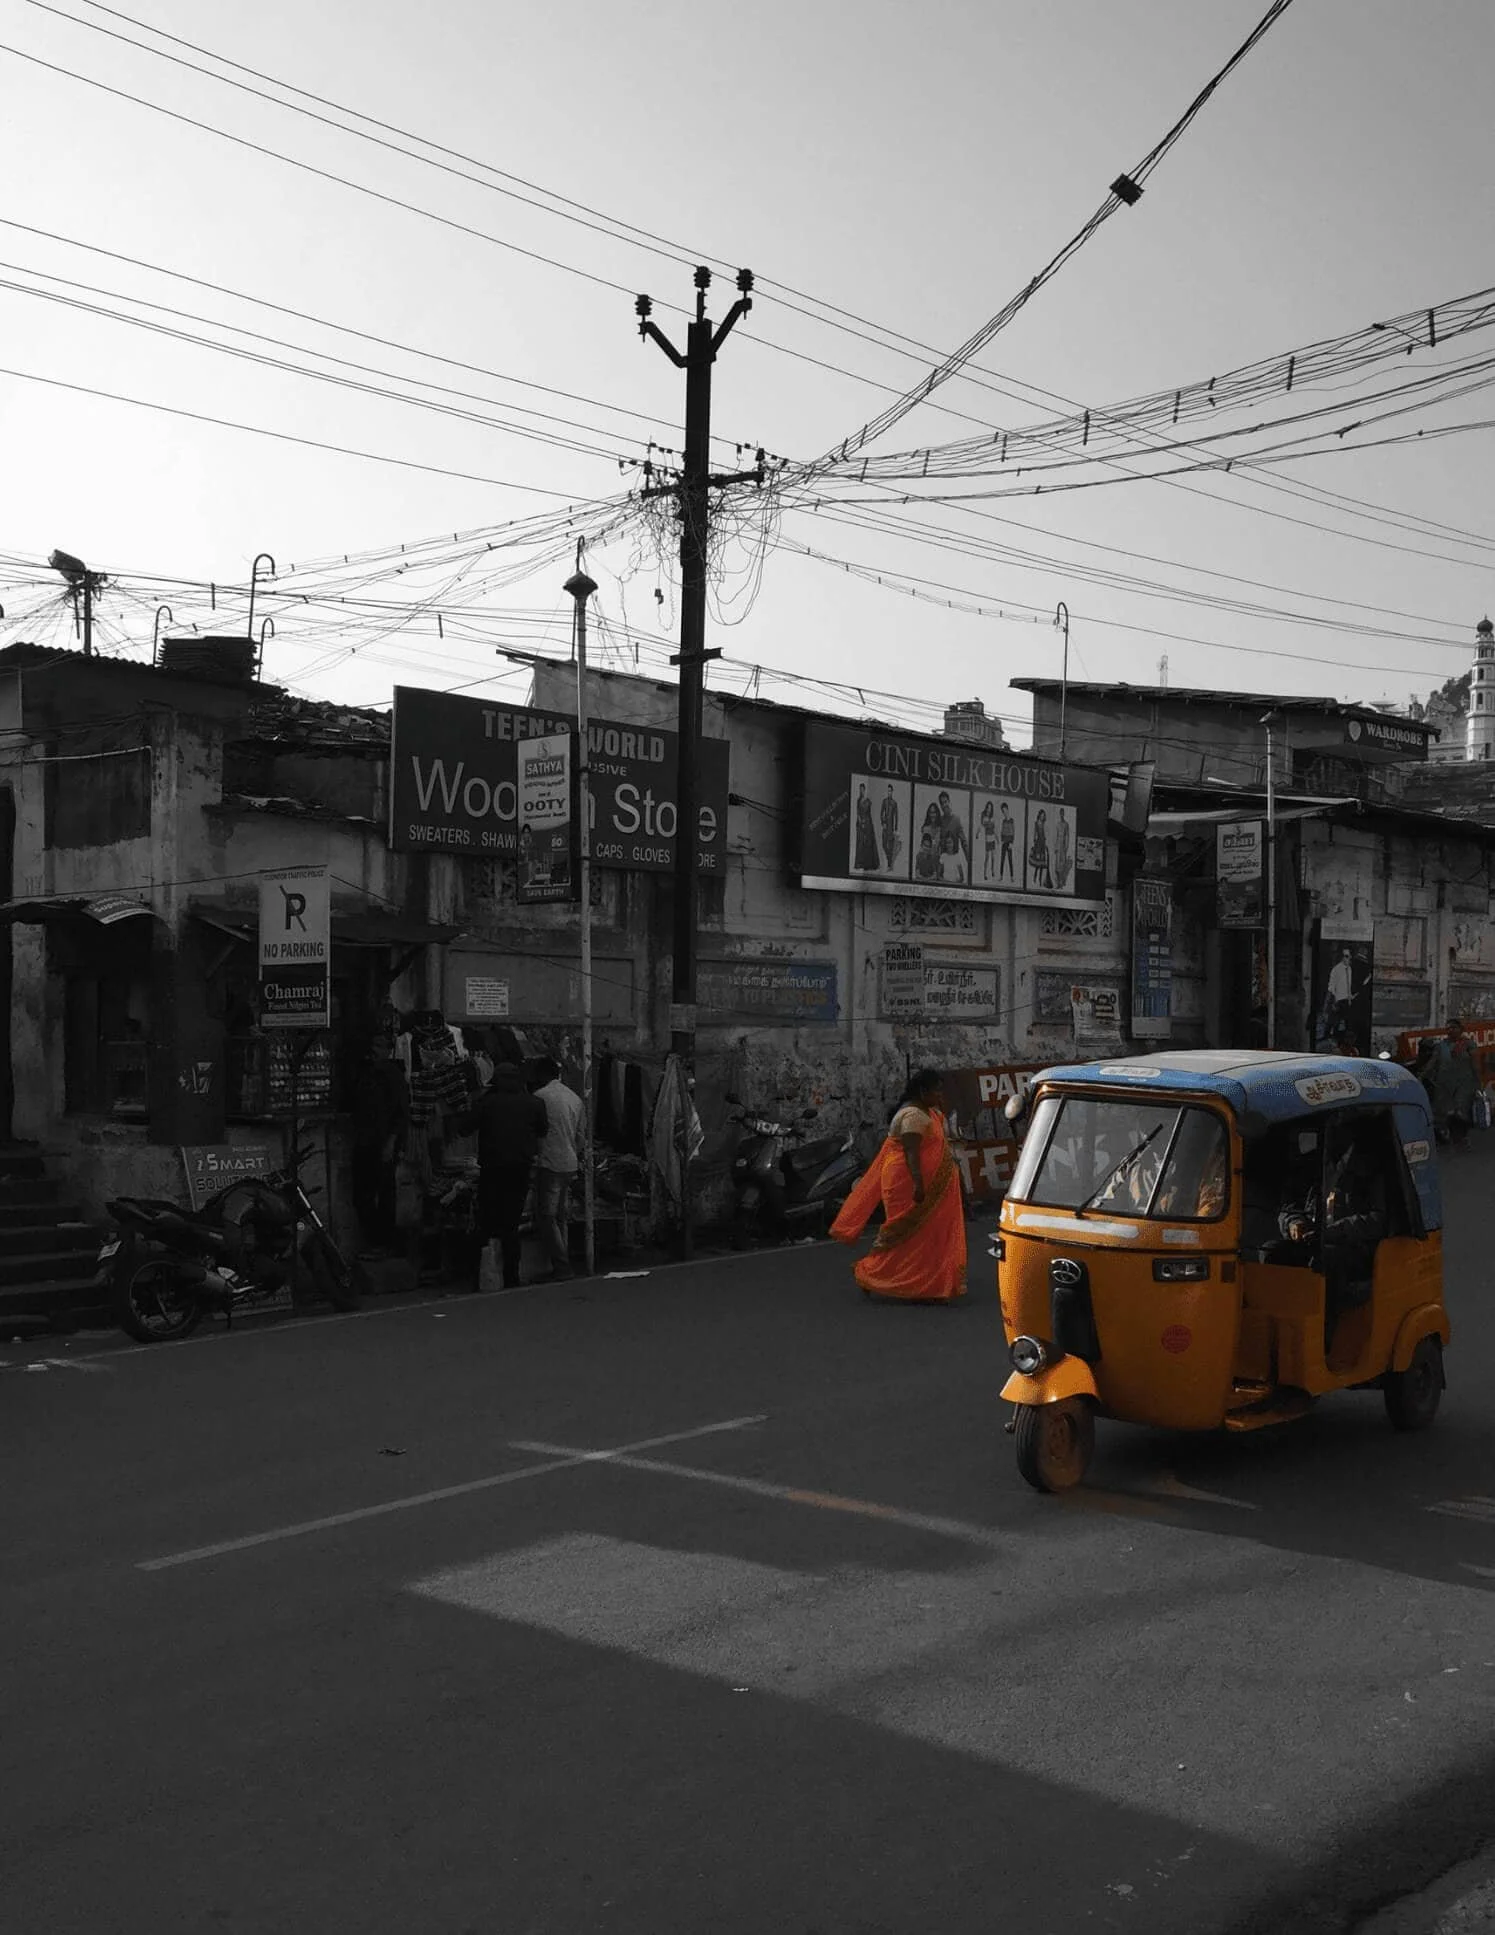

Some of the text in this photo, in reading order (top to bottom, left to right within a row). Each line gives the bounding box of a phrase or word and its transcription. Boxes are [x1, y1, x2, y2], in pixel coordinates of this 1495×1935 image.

[1366, 722, 1424, 746] WARDROBE
[588, 726, 665, 763] WORLD
[526, 760, 563, 776] SATHYA
[588, 761, 628, 777] USIVE
[866, 740, 1065, 800] CINI SILK HOUSE
[524, 798, 566, 812] OOTY
[612, 783, 717, 842] Stoe
[408, 824, 471, 845] SWEATERS
[481, 831, 517, 849] SHAW
[596, 842, 624, 860] CAPS
[632, 846, 671, 864] GLOVES
[264, 942, 325, 958] NO PARKING
[886, 947, 921, 961] PARKING
[264, 980, 325, 1000] Chamraj
